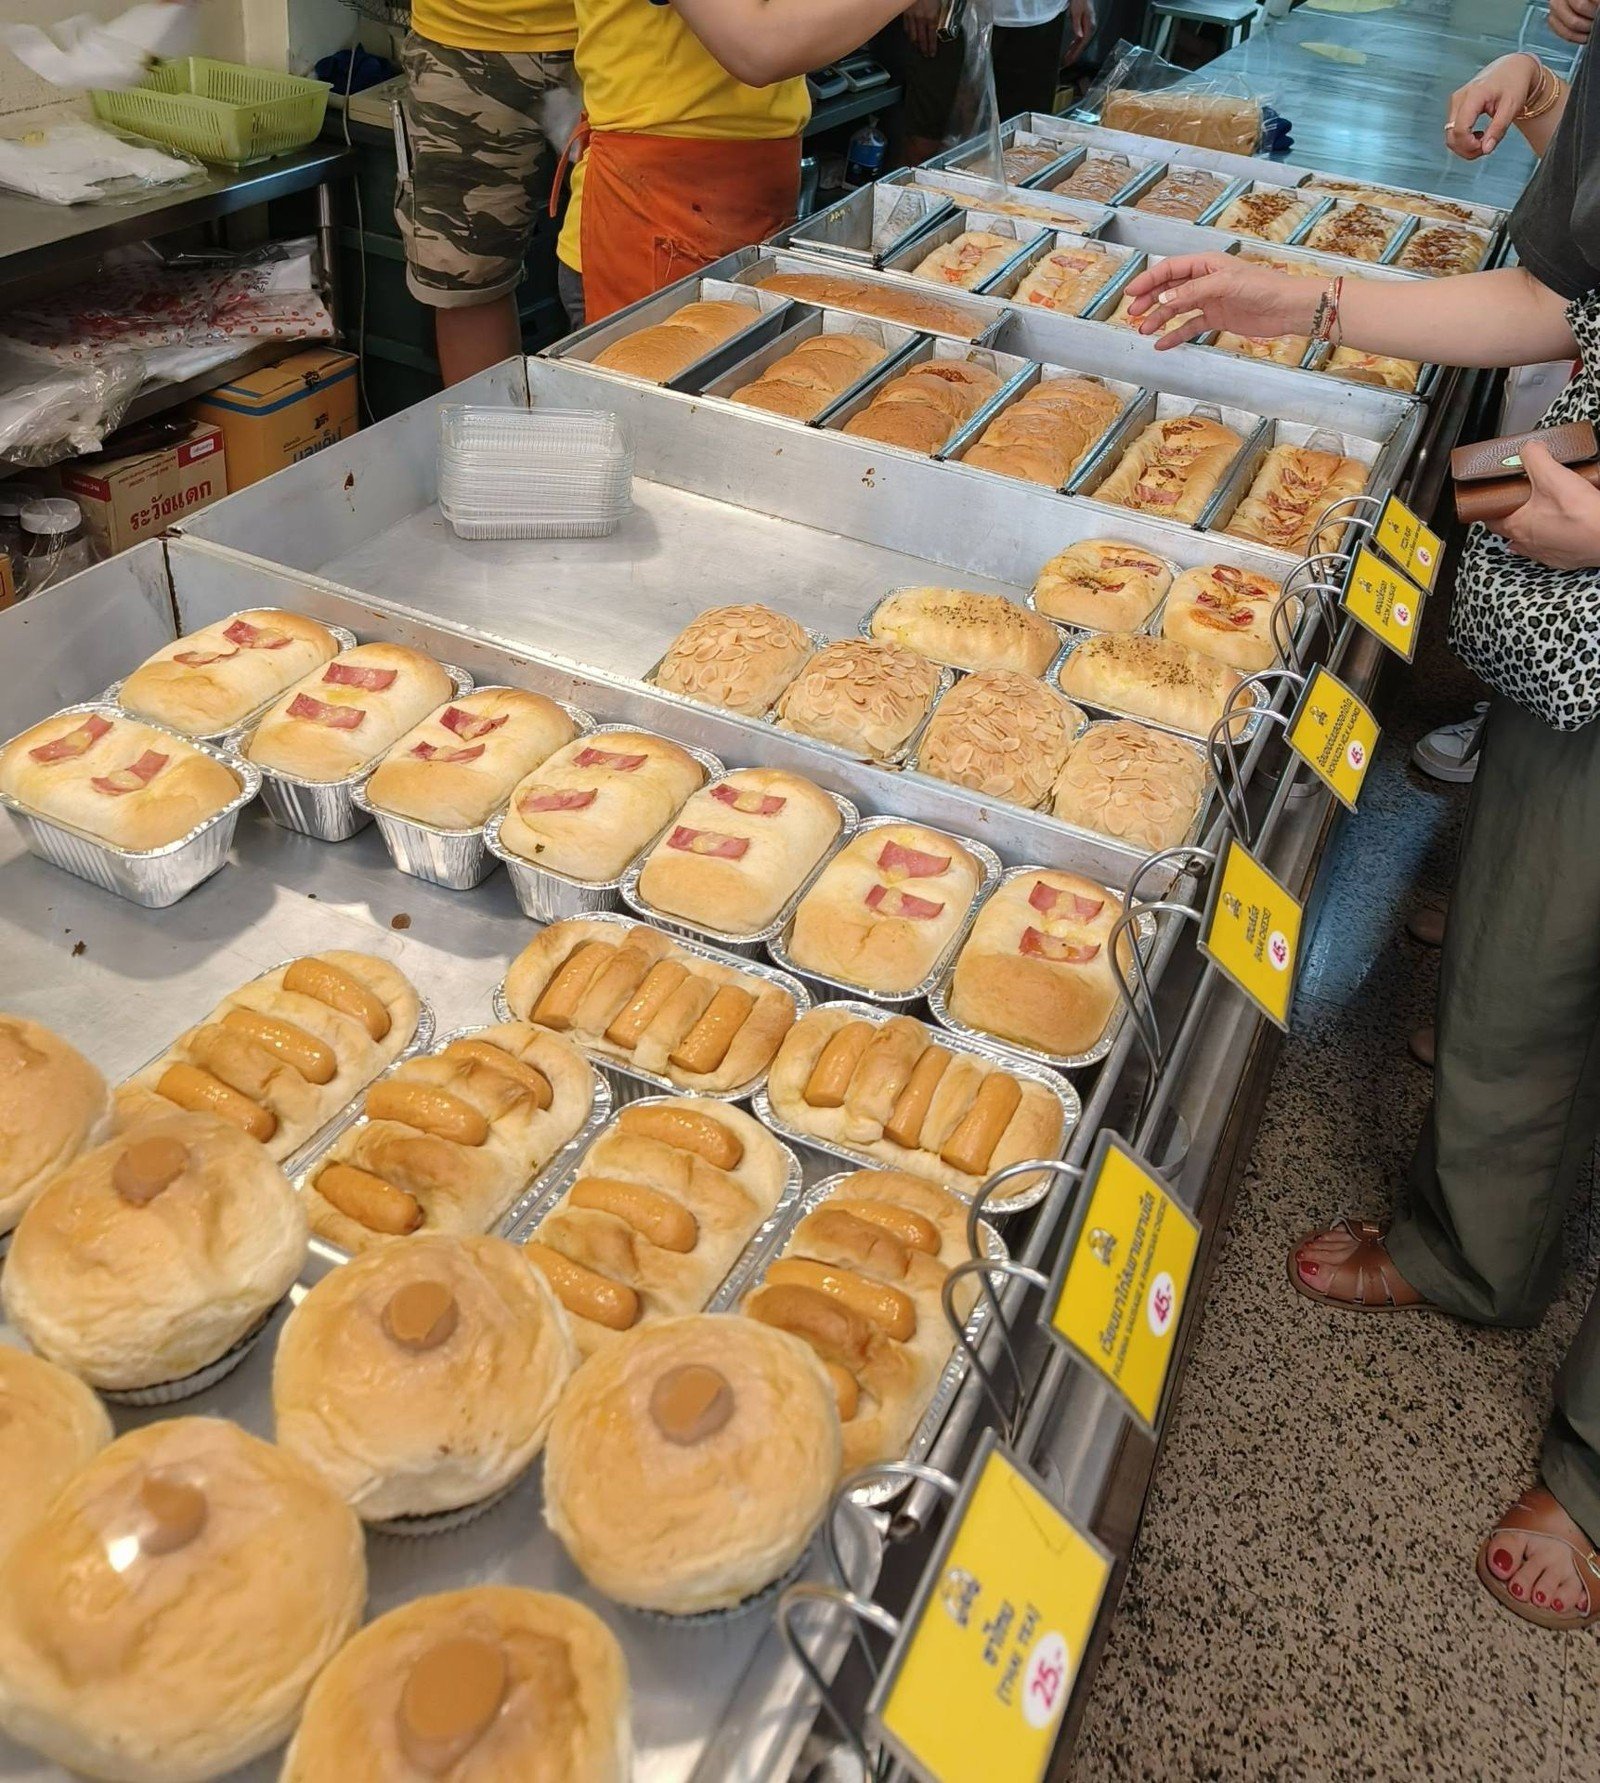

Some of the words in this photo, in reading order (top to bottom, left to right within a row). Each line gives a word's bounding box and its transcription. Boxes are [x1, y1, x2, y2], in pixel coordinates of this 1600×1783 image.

[129, 480, 212, 531] ระวังแตก
[982, 1598, 1016, 1667] ชาไทย
